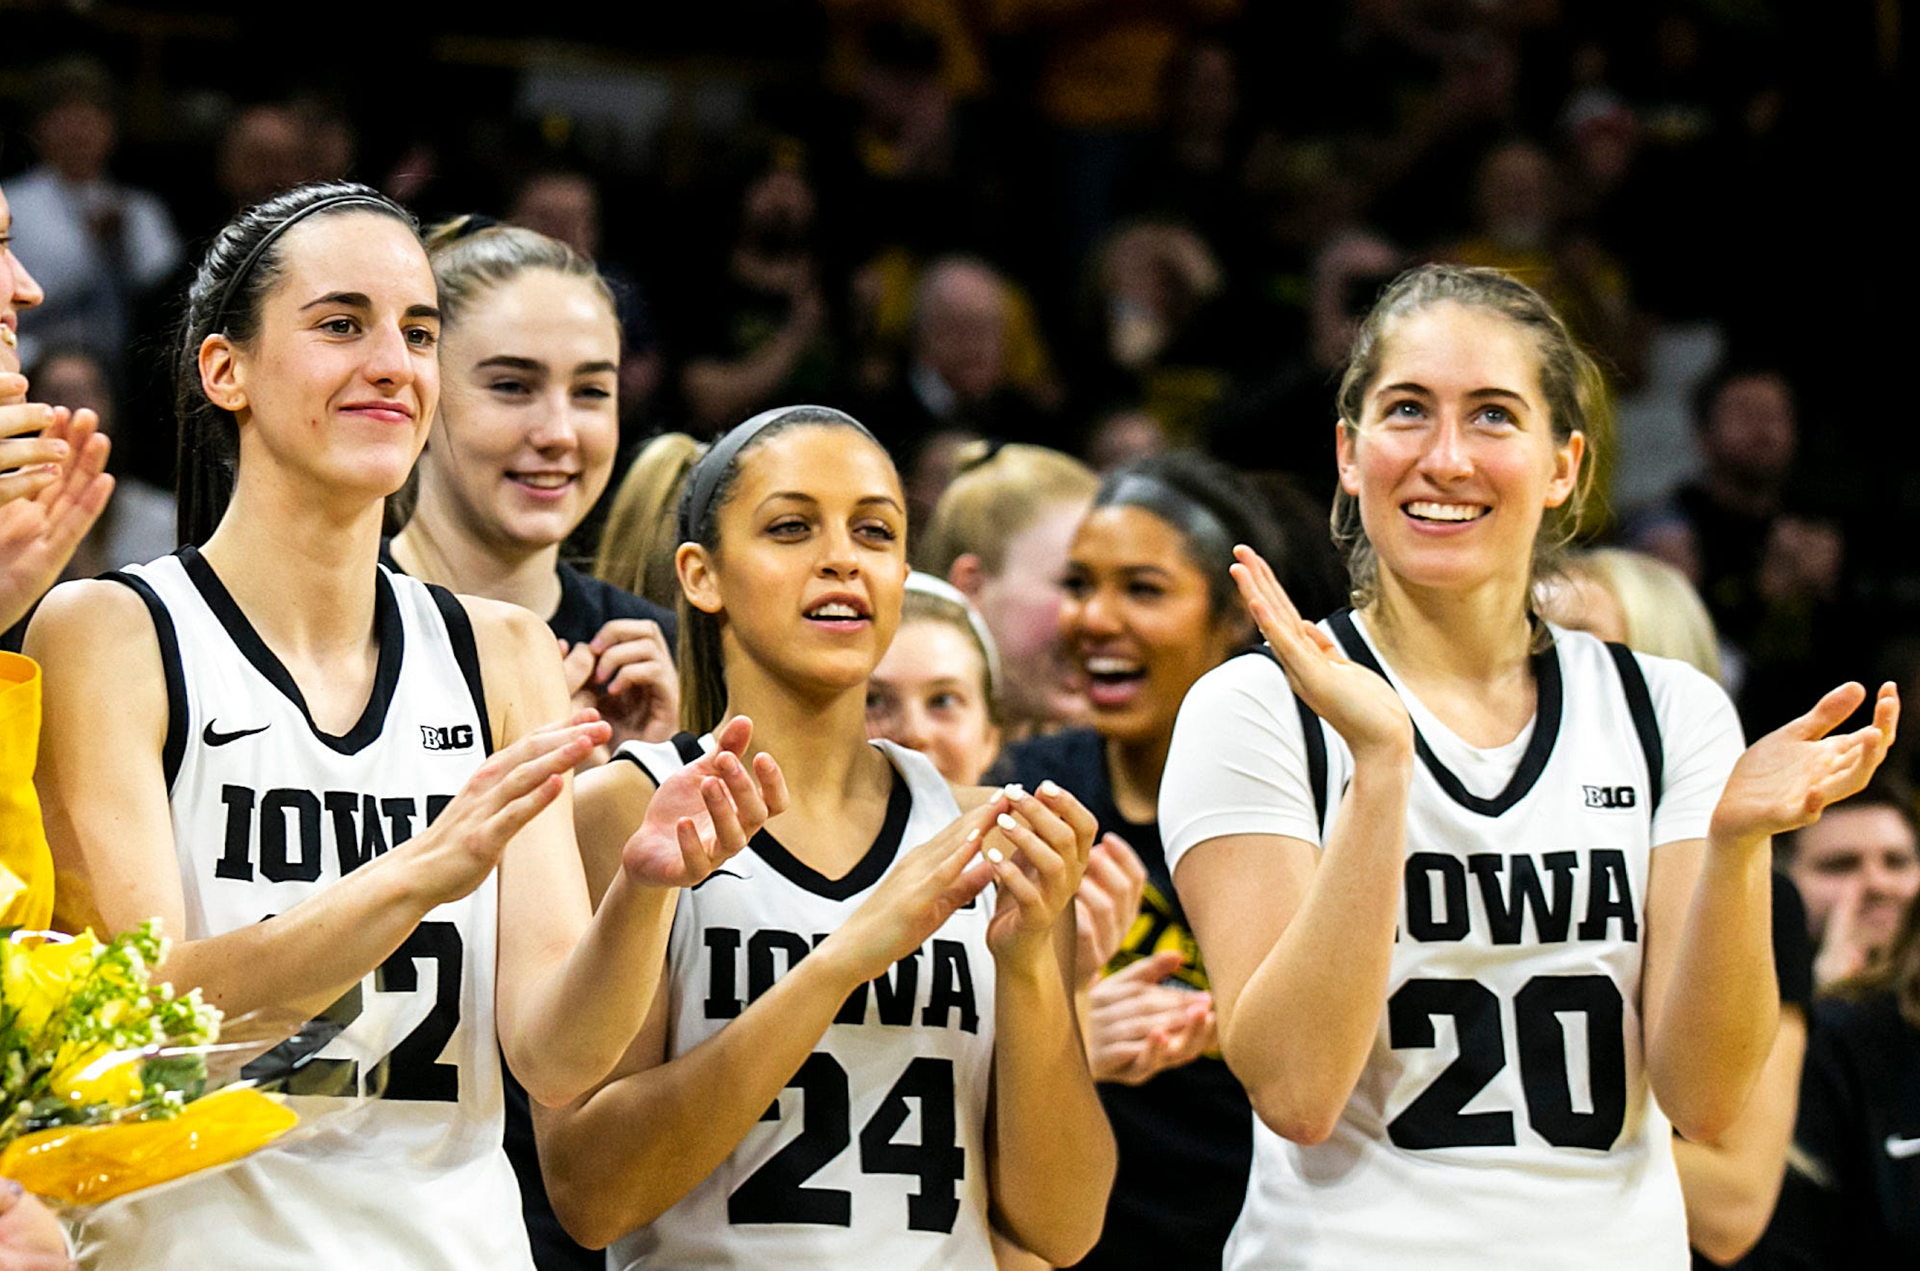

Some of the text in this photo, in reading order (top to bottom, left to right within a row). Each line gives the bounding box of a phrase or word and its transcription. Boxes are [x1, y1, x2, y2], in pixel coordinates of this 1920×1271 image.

[215, 784, 457, 882] IOW
[1395, 849, 1637, 945] OWA
[1387, 975, 1626, 1151] 20
[728, 1052, 965, 1234] 24
